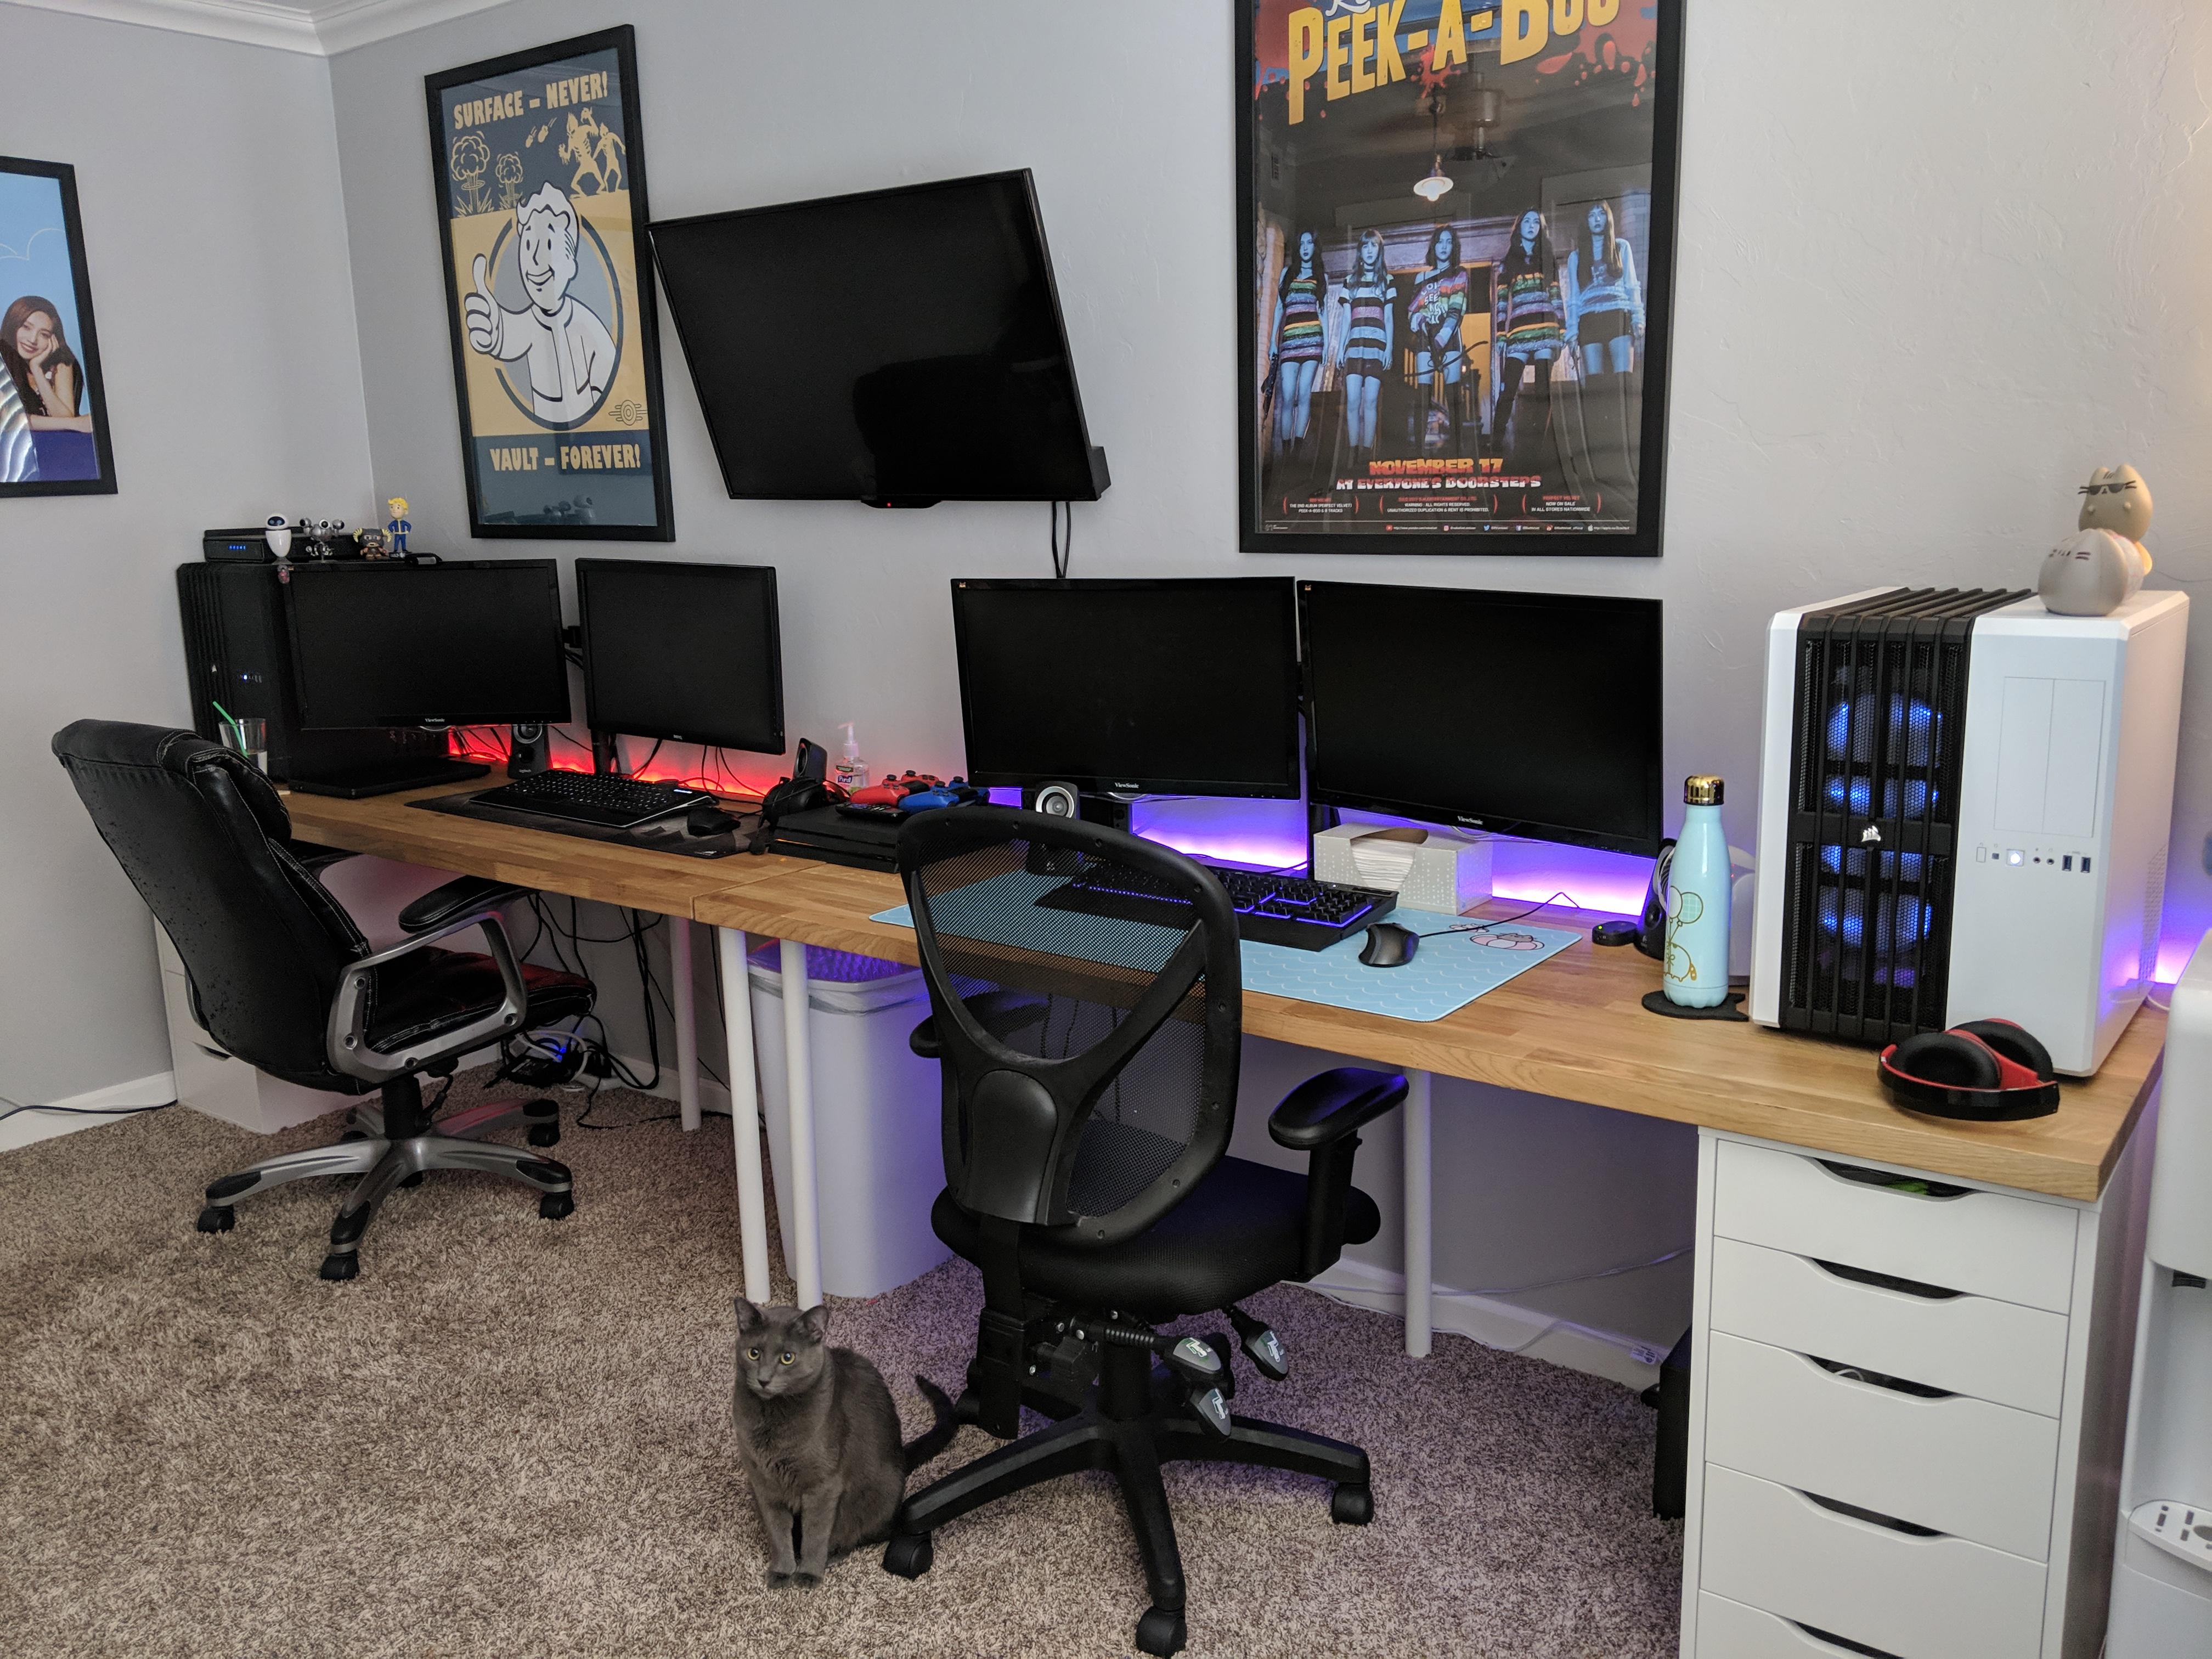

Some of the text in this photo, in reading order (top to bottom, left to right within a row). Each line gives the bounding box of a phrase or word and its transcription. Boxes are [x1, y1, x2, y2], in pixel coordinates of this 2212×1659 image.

[453, 91, 524, 129] SURFACE
[546, 71, 608, 110] NEVER!
[490, 447, 539, 471] VAULT
[560, 444, 641, 470] FOREVER!
[1369, 458, 1503, 475] NOVEMBER 17
[1357, 476, 1442, 489] EVERYONE'S
[1445, 475, 1542, 489] DOORSTEPS
[1457, 815, 1483, 825] ViewSonic
